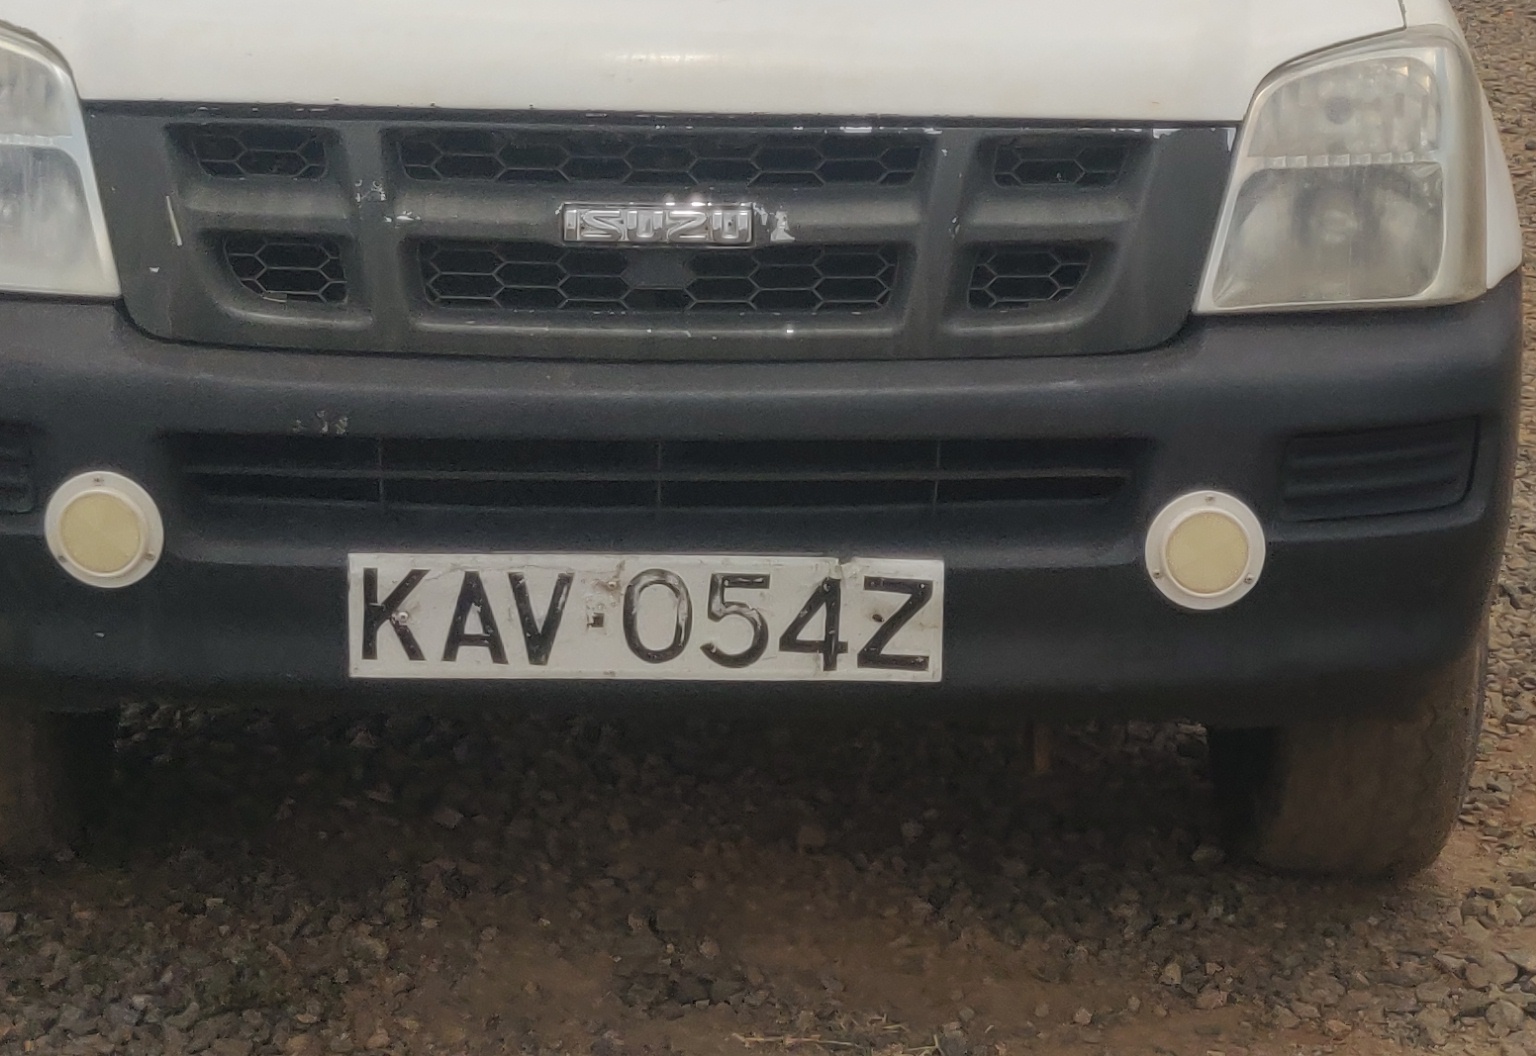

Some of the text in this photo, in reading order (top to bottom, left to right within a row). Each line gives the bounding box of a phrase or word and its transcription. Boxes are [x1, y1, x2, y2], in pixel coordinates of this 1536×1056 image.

[565, 208, 752, 243] ISUZU
[360, 567, 935, 673] KAV 054Z
